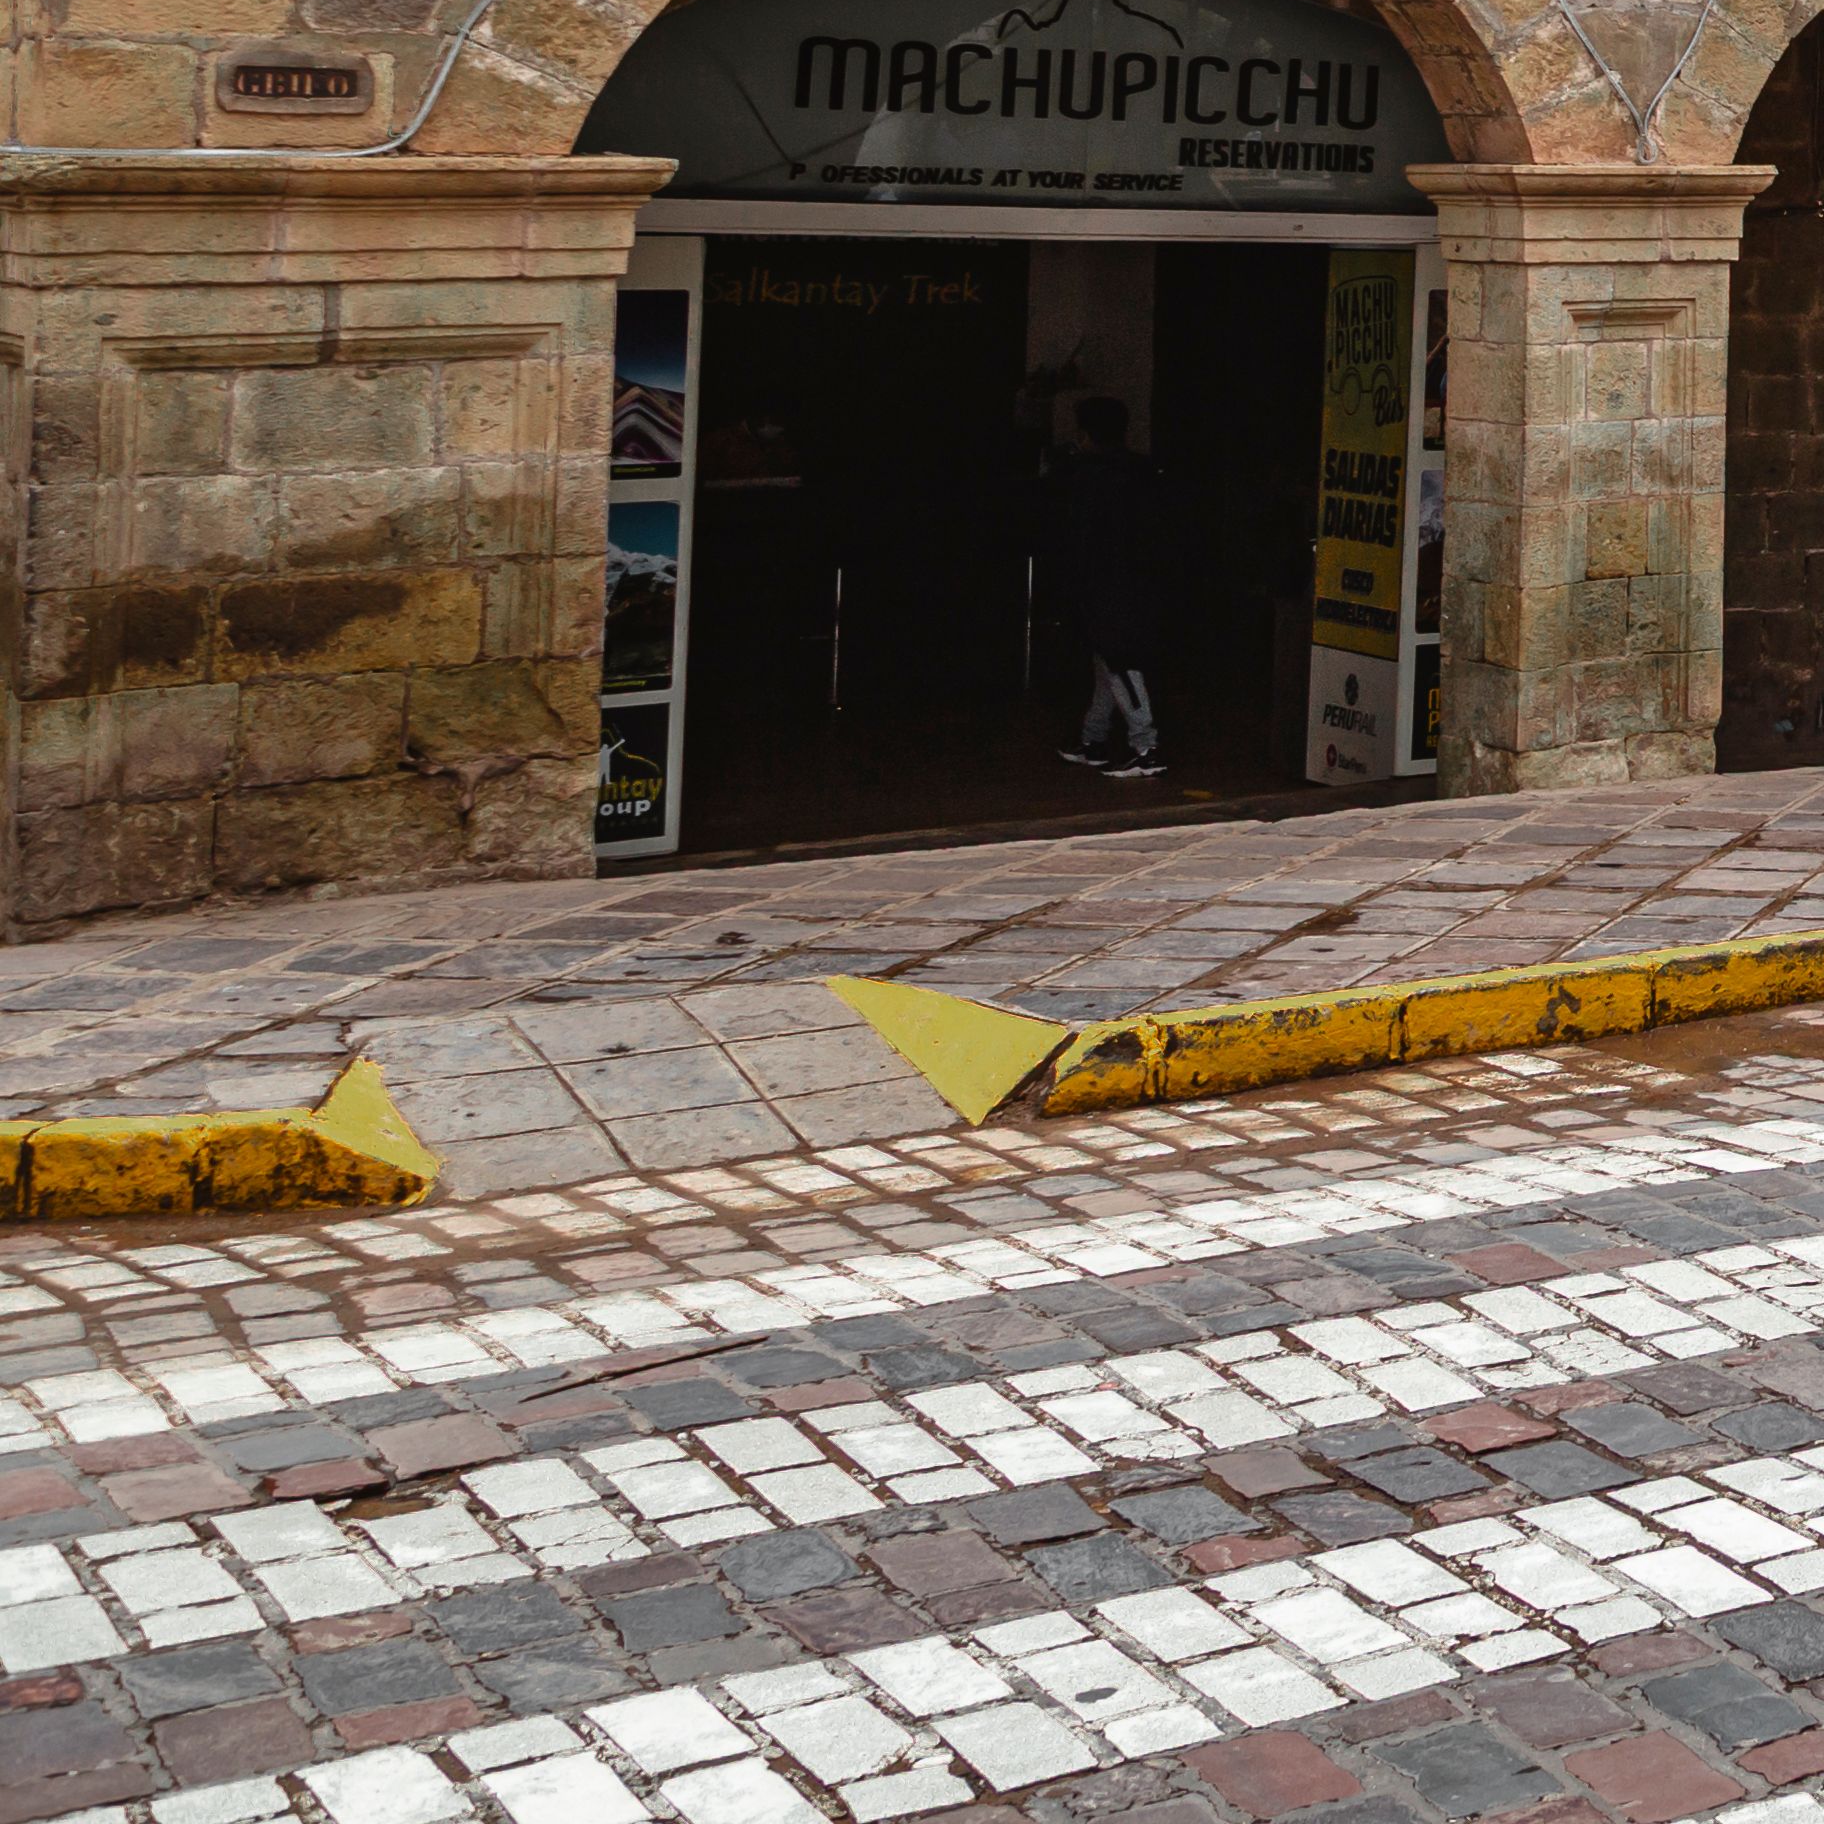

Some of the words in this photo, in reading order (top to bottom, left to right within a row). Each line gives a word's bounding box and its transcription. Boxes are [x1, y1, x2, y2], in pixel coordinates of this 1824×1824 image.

[795, 35, 1378, 131] MACHUPICCHU
[789, 162, 983, 187] POFESSIONALS
[990, 168, 1022, 188] AT
[1027, 169, 1083, 190] YOUR
[1093, 172, 1184, 192] SERVICE
[1179, 136, 1375, 174] RESERVATIONS
[703, 265, 889, 316] Salkantay
[903, 271, 983, 305] Trek
[1334, 280, 1394, 328] MACHU
[1335, 320, 1394, 369] PICCHU
[1373, 385, 1405, 427] Bus
[1324, 447, 1402, 499] SALIDAS
[1323, 495, 1398, 548] DIARIAS
[1322, 703, 1377, 737] PERURAIL
[599, 799, 652, 817] oup
[600, 776, 665, 801] ntay
